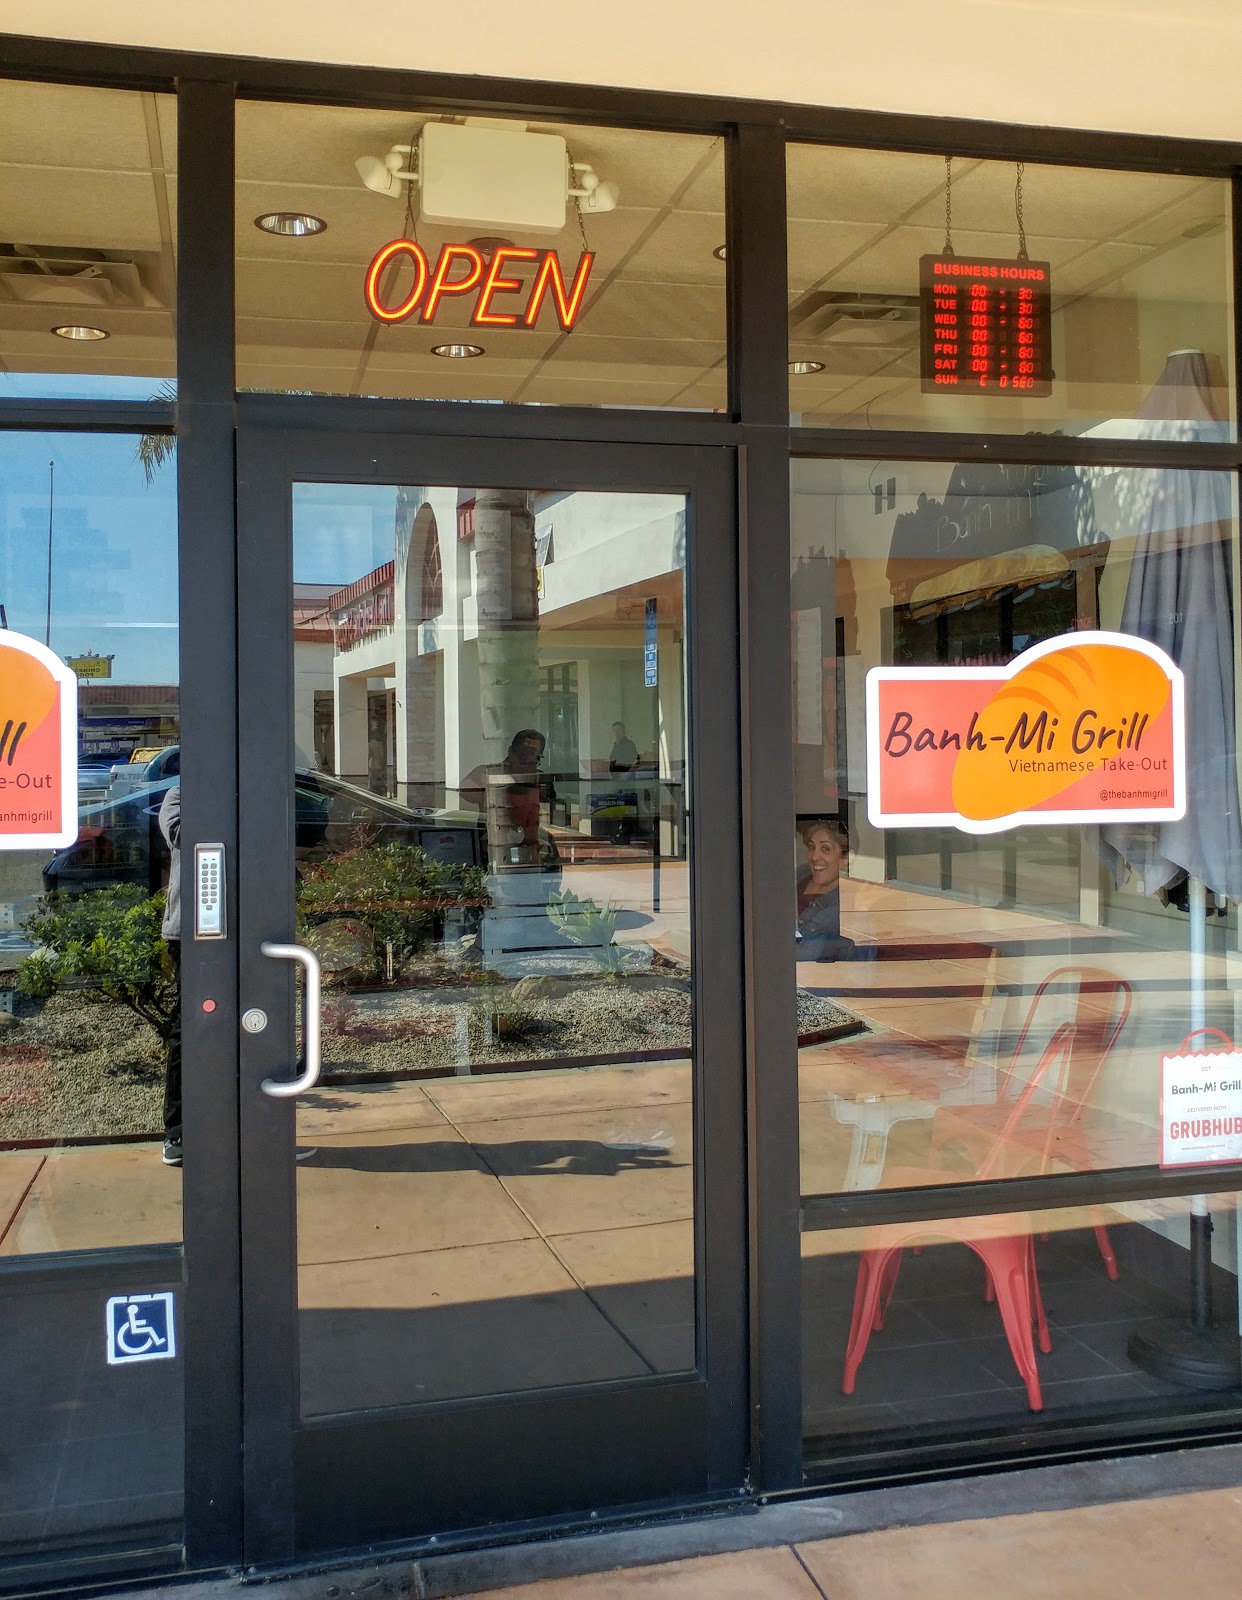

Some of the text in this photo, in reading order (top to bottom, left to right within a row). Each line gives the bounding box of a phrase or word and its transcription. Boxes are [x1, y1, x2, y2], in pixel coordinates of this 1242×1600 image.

[933, 263, 1045, 280] BUSINESS HOURS
[366, 240, 594, 329] OPEN
[933, 283, 957, 295] MON
[934, 299, 957, 310] TUE
[934, 314, 957, 325] WED
[934, 329, 958, 340] THU
[934, 344, 958, 355] FRI
[934, 359, 957, 370] SAT
[934, 374, 958, 385] SUN
[884, 709, 1149, 758] Banh-Mi Grill
[1008, 757, 1168, 773] Vietnamese Take-Out
[1100, 789, 1168, 801] @thebanhmigrill
[1171, 1080, 1241, 1095] Banh-Mi Grill
[1170, 1117, 1242, 1140] GRUBHUB
